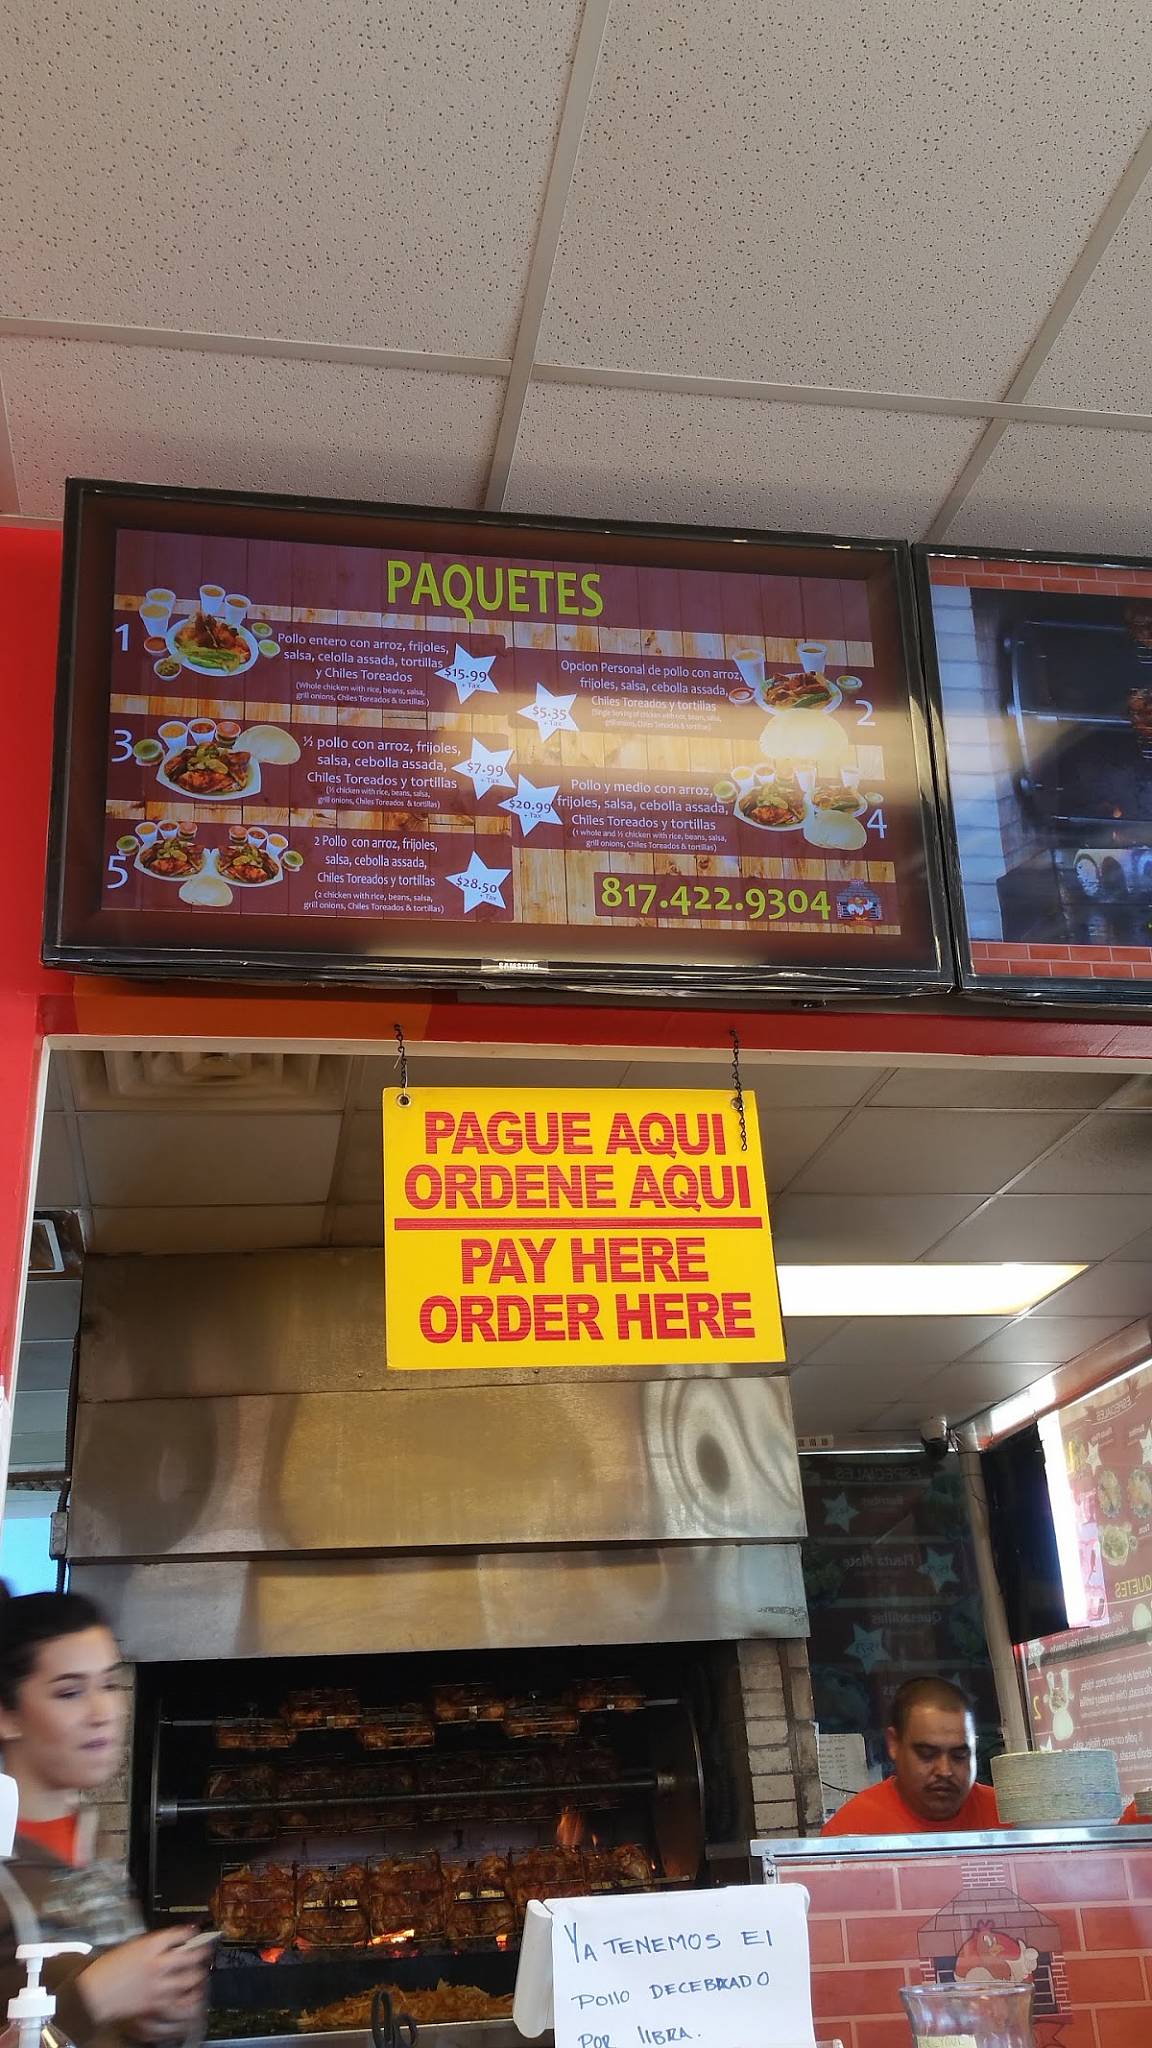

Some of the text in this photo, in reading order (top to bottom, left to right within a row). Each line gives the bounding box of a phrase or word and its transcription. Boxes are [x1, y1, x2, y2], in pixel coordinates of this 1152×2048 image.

[387, 560, 604, 623] PAQUETES
[114, 624, 130, 651] 1
[278, 632, 449, 655] Pollo entero con arroz, frijoles,
[283, 650, 443, 668] salsa, celolla assada, tortillas
[315, 666, 413, 682] y Chiles Toreados
[444, 668, 487, 682] $15.99
[561, 660, 743, 682] Opcion Personal de pollo con arroz,
[296, 682, 425, 696] (Whole chicken with rice, beans, salsa,
[580, 677, 730, 697] frijoles, salsa, cebolla assada,
[296, 692, 309, 700] grill
[310, 693, 336, 702] onions,
[358, 695, 390, 703] Toreados
[591, 695, 717, 712] Chiles Toreados y tortillas
[533, 707, 567, 719] $5.35
[855, 699, 876, 726] 2
[111, 730, 133, 762] 3
[303, 737, 461, 756] ½ pollo con arroz, frijoles,
[317, 755, 447, 772] salsa, cebolla assada,
[467, 762, 504, 777] $7.99
[307, 772, 457, 788] Chiles Toreados y tortillas
[571, 779, 714, 797] Pollo y medio con arroz,
[331, 797, 354, 806] onions,
[356, 797, 374, 805] Chiles
[375, 798, 404, 806] Toreados
[336, 787, 360, 795] chicken
[376, 788, 390, 797] rice,
[391, 789, 412, 798] beans,
[413, 790, 431, 799] salsa,
[509, 799, 551, 814] $20.99
[557, 797, 729, 815] frijoles, salsa, cebolla assada,
[571, 814, 716, 830] Chiles Toreados y tortillas
[867, 808, 888, 839] 4
[314, 835, 438, 852] 2 Pollo con arroz, frijoles,
[580, 829, 601, 837] whole
[625, 830, 651, 838] chicken
[652, 831, 668, 839] with
[669, 832, 683, 841] rice,
[685, 832, 707, 842] beans,
[708, 833, 728, 842] salsa,
[586, 839, 599, 848] grill
[600, 840, 626, 849] onions,
[648, 841, 680, 850] Toreados
[688, 843, 717, 852] tortillas)
[325, 854, 427, 869] salsa, cebolla assada,
[107, 855, 129, 889] 5
[317, 872, 436, 887] Chiles Toreados y tortillas
[456, 877, 498, 893] $28.50
[314, 891, 433, 903] (2 chicken with rice, beans, salsa,
[601, 877, 831, 920] 817.422.9304
[303, 901, 320, 910] grill
[321, 901, 346, 910] onions,
[347, 902, 369, 910] Chiles
[371, 903, 404, 911] Toreados
[413, 904, 445, 914] tortillas)
[498, 962, 539, 970] SAMSUNG
[425, 1111, 726, 1159] PAGUE AQUI
[405, 1165, 751, 1213] ORDENE AQUI
[461, 1237, 709, 1284] PAY HERE
[419, 1292, 755, 1344] ORDER HERE
[603, 1933, 721, 1955] TENEMOS
[578, 2033, 615, 2048] POR
